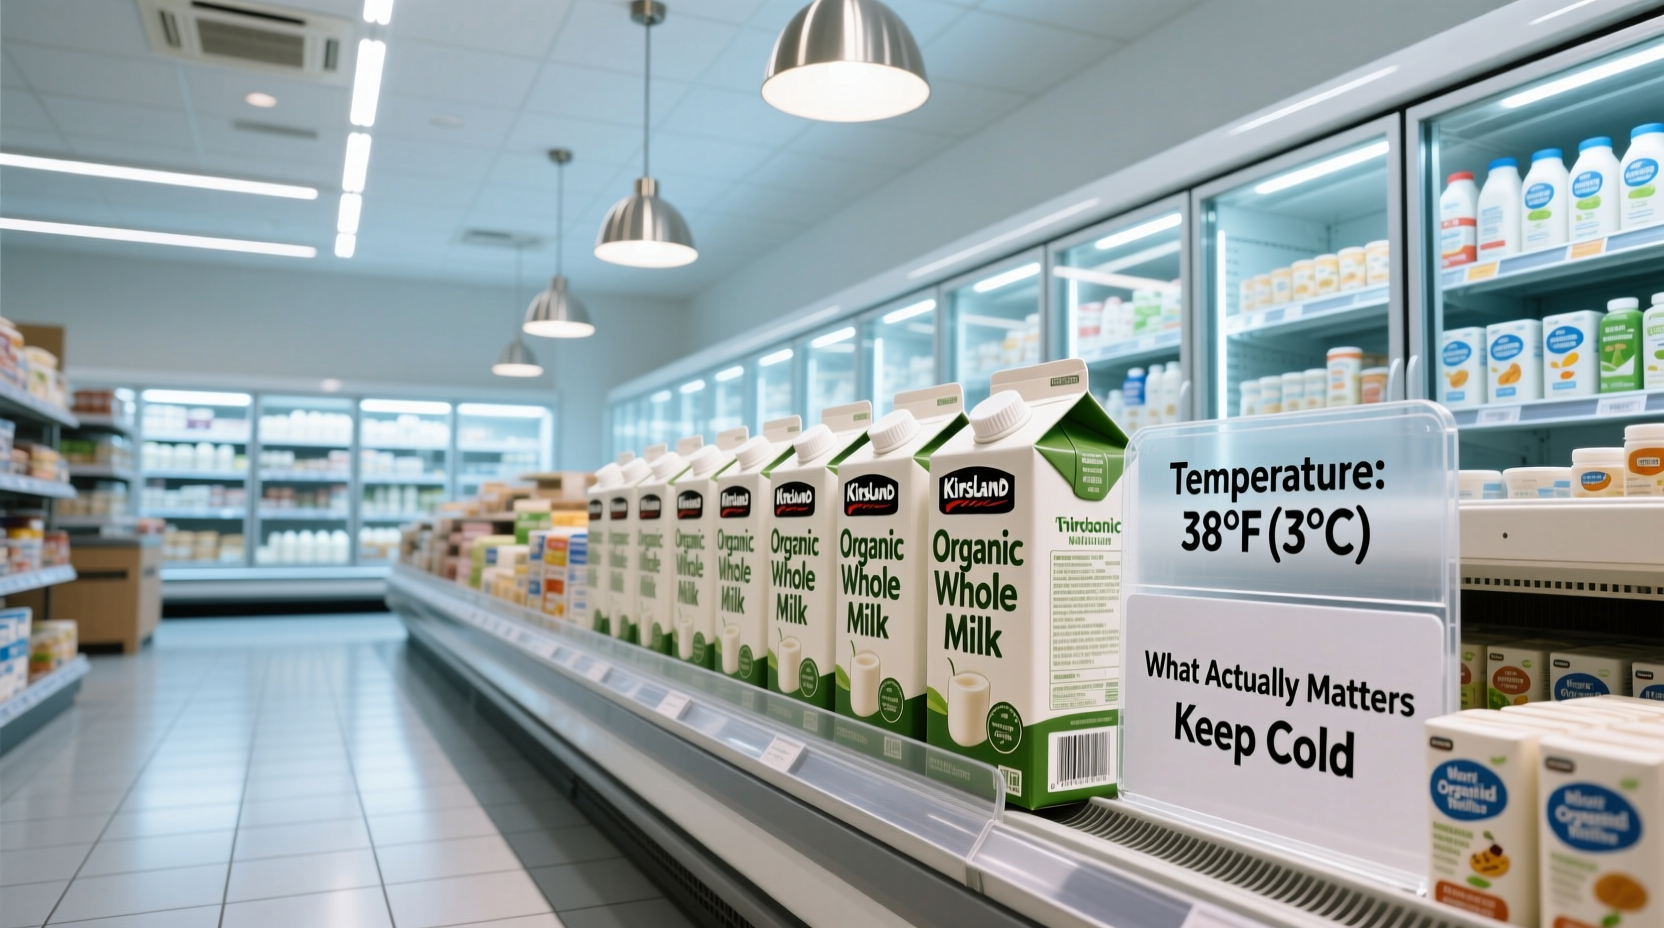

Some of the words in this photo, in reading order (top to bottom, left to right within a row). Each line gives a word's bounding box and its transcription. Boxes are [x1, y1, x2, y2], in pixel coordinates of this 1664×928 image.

[1169, 457, 1386, 503] Temperature:
[718, 528, 754, 557] Organic
[770, 528, 820, 561] Organic
[840, 528, 905, 567] Organic
[932, 528, 1024, 573] Organic
[1181, 508, 1260, 554] 38°F
[1268, 504, 1372, 566] (3°C)
[719, 556, 752, 584] Whole
[771, 560, 816, 592] Whole
[841, 564, 901, 600] Whole
[721, 586, 745, 614] Milk
[776, 593, 808, 626] Milk
[934, 570, 1018, 612] Whole
[847, 602, 889, 640] Milk
[944, 613, 1003, 658] Milk
[1144, 650, 1201, 684] What
[1205, 659, 1301, 708] Actually
[1306, 674, 1415, 717] Matters
[1174, 702, 1257, 767] Keep
[1265, 719, 1355, 779] Cold
